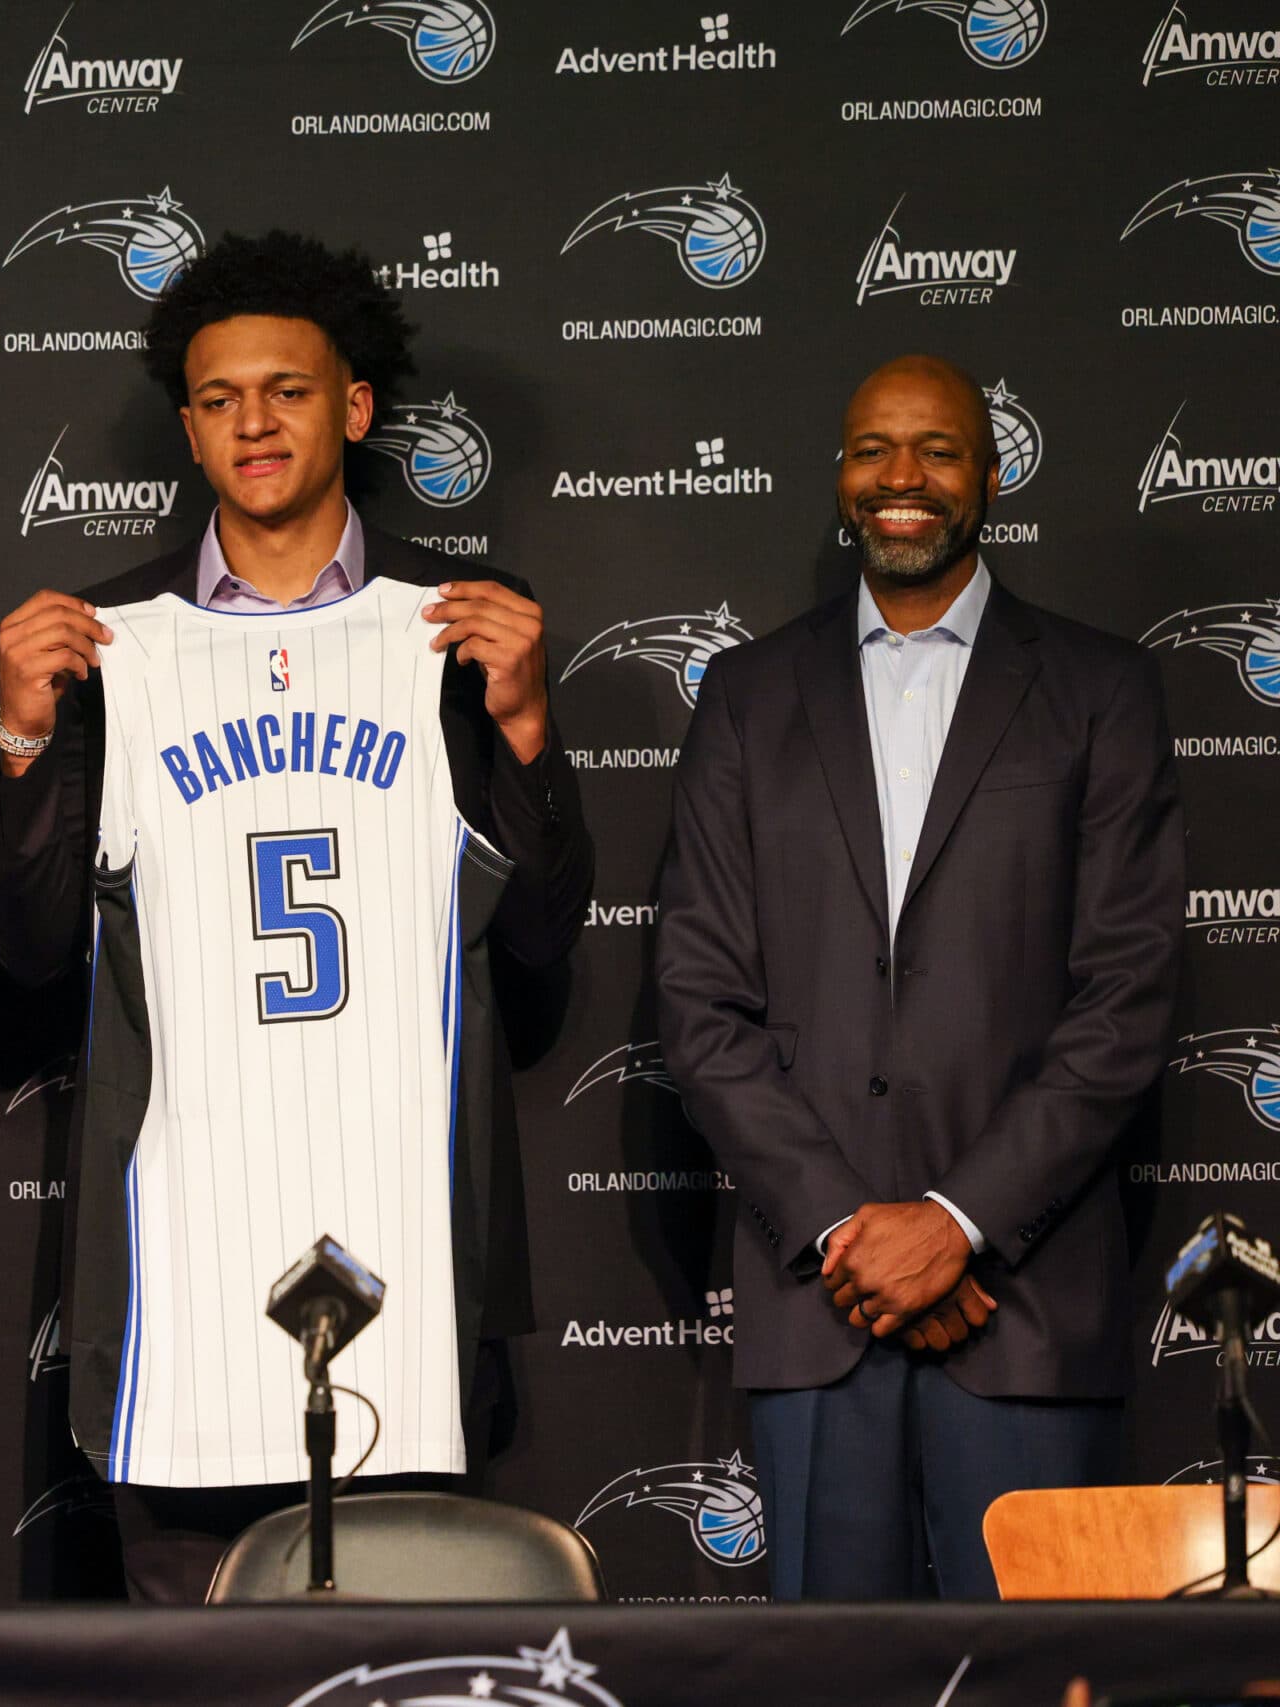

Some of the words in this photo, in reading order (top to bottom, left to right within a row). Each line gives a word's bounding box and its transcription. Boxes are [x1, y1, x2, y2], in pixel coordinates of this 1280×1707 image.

[42, 53, 182, 95] Amway
[87, 97, 159, 113] CENTER
[842, 98, 1041, 121] ORLANDOMAGIC.COM
[292, 112, 489, 134] ORLANDOMAGIC.COM
[874, 243, 1017, 286] Amway
[920, 288, 993, 305] CENTER
[563, 317, 761, 340] ORLANDOMAGIC.COM
[1155, 449, 1280, 492] Amwa
[38, 475, 178, 517] Amway
[1203, 496, 1275, 512] CENTER
[84, 519, 155, 536] CENTER
[162, 713, 405, 803] BANCHERO
[247, 828, 349, 1025] 5
